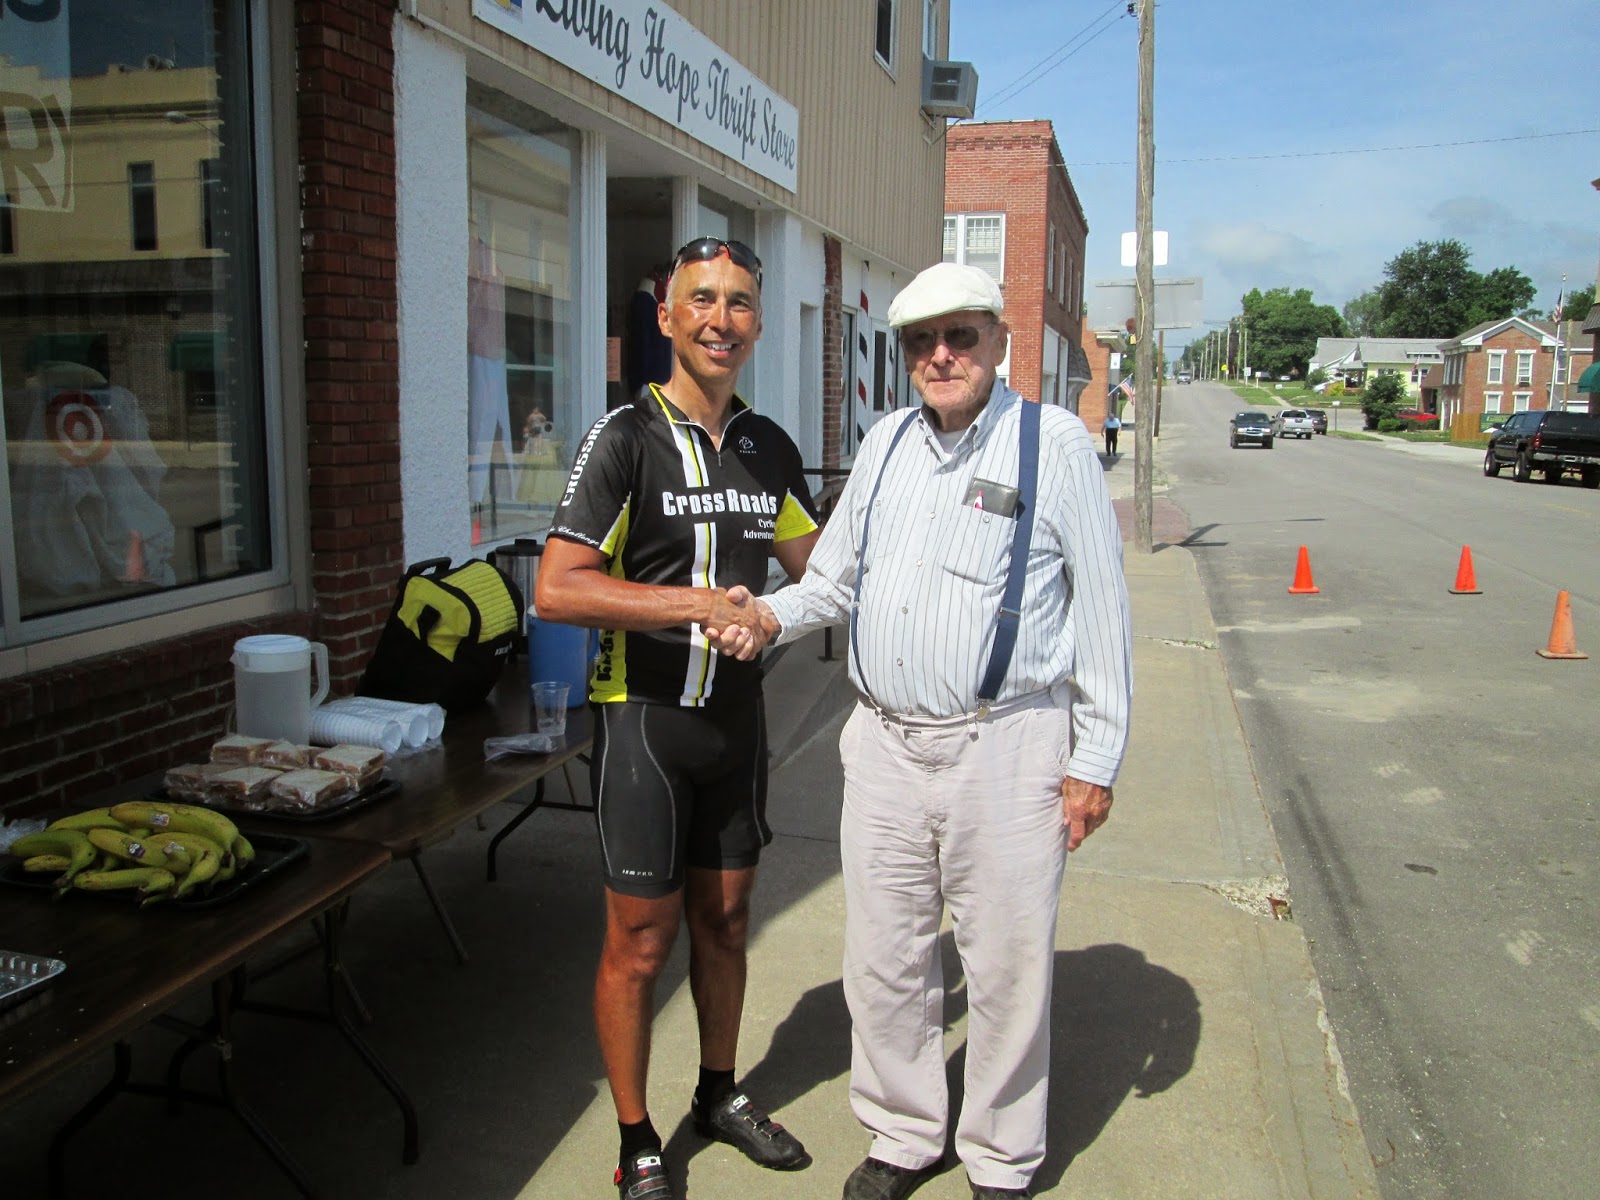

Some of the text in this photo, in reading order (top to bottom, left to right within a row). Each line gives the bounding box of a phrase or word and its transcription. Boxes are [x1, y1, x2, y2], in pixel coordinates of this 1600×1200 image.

[535, 0, 795, 170] iving Hope Thrift Store
[636, 1155, 661, 1169] SIDI
